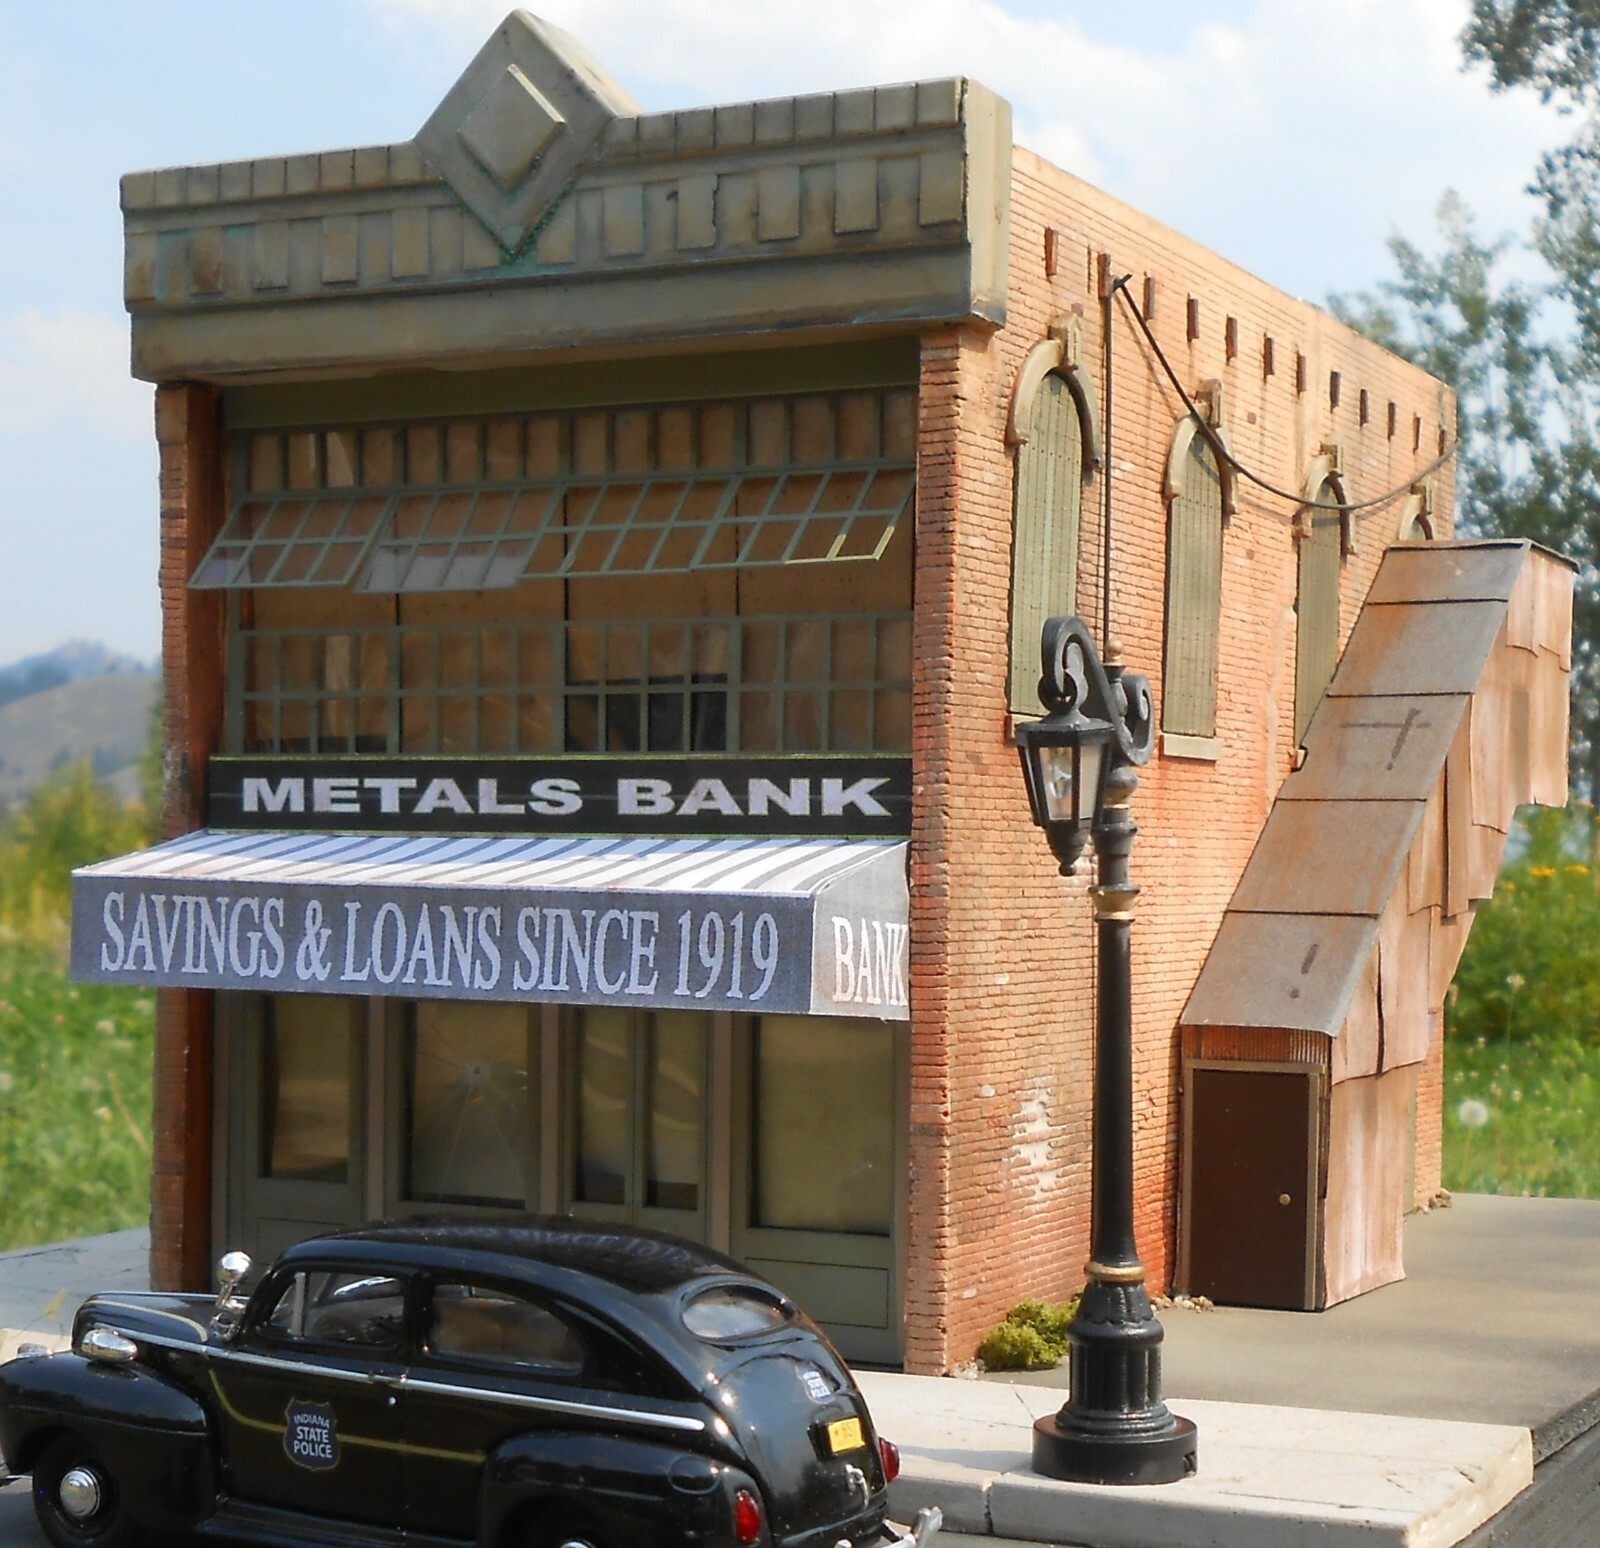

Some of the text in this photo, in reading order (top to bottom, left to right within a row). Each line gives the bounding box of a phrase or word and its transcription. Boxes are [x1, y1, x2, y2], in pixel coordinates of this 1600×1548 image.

[242, 777, 891, 817] METALS BANK
[100, 891, 780, 1002] SAVINGS & LOANS SINCE 1919
[831, 915, 909, 1008] BANK
[293, 1413, 330, 1429] INDIANA
[296, 1426, 329, 1443] STATE
[293, 1440, 333, 1458] POLICE
